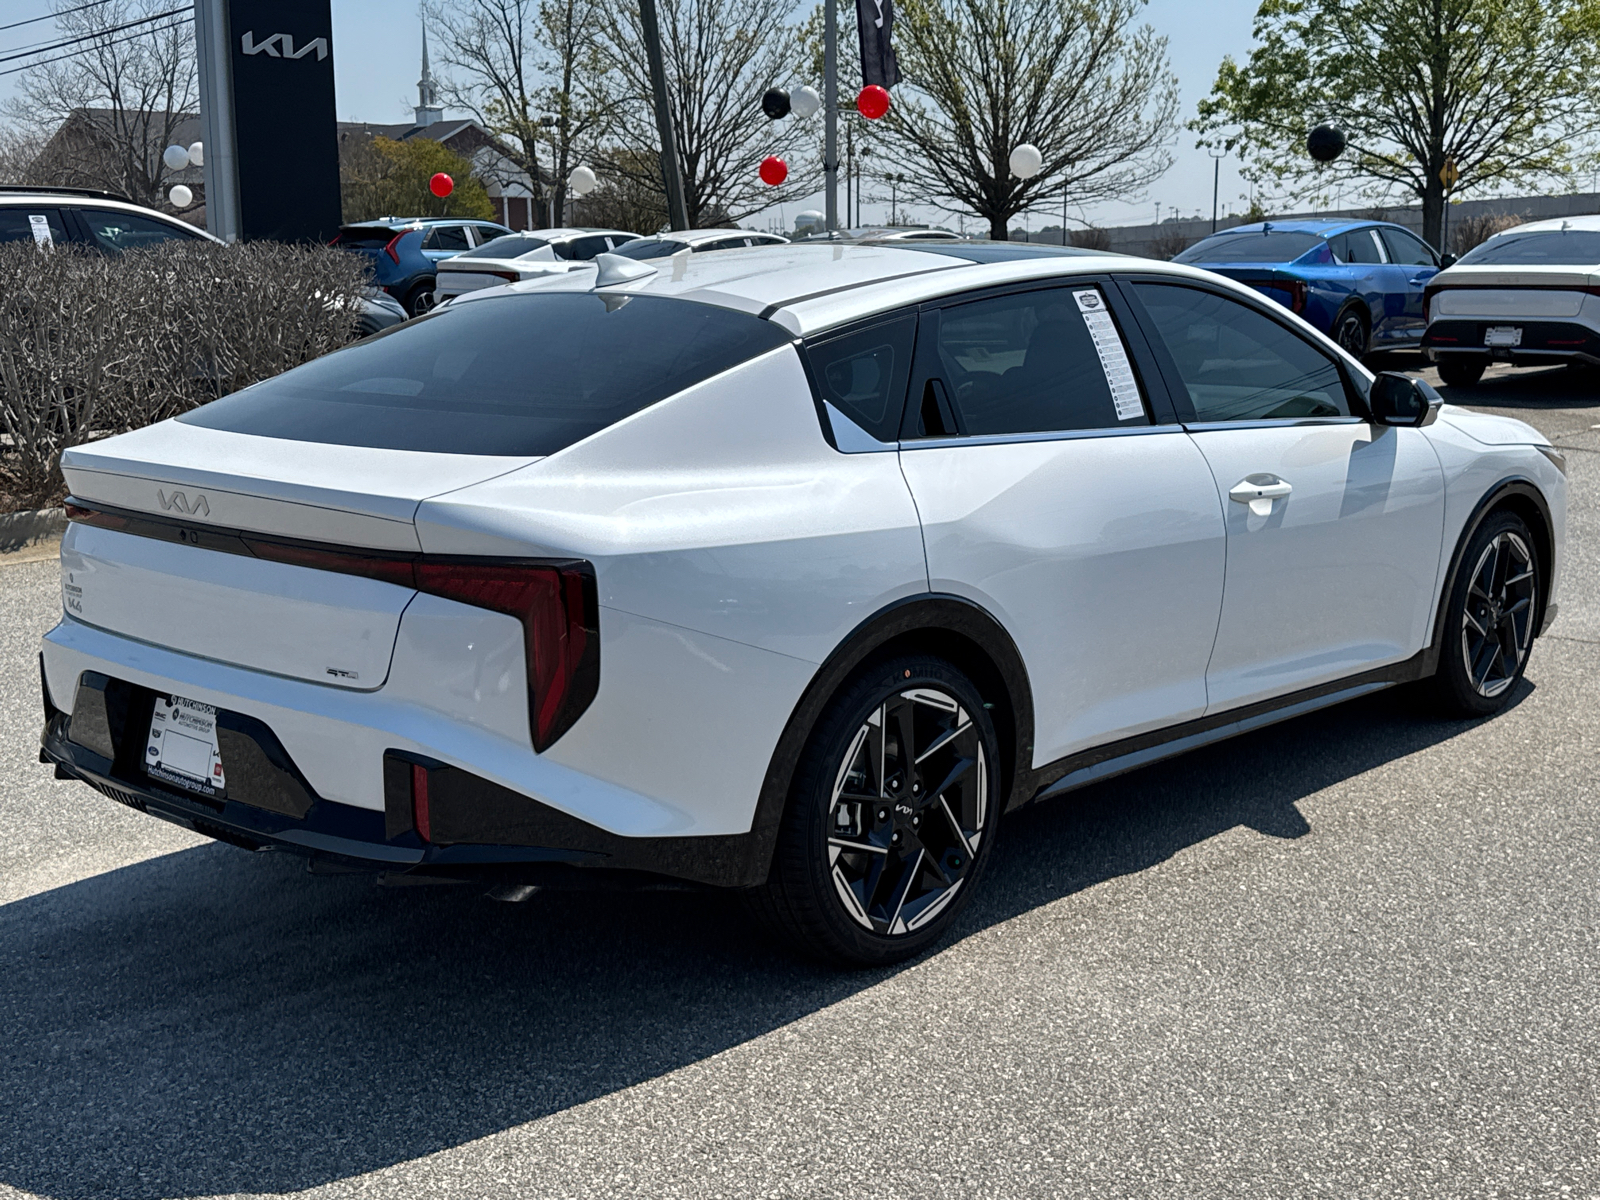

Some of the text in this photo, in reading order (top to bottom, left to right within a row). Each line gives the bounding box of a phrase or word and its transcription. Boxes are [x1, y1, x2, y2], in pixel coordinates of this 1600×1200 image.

[241, 30, 328, 62] KIA
[157, 488, 210, 517] KIA
[68, 597, 83, 614] K4
[178, 697, 216, 715] HUTCHINSON
[179, 712, 213, 729] HUTCHINSON
[147, 765, 215, 795] Hutchinsonautogroup.com
